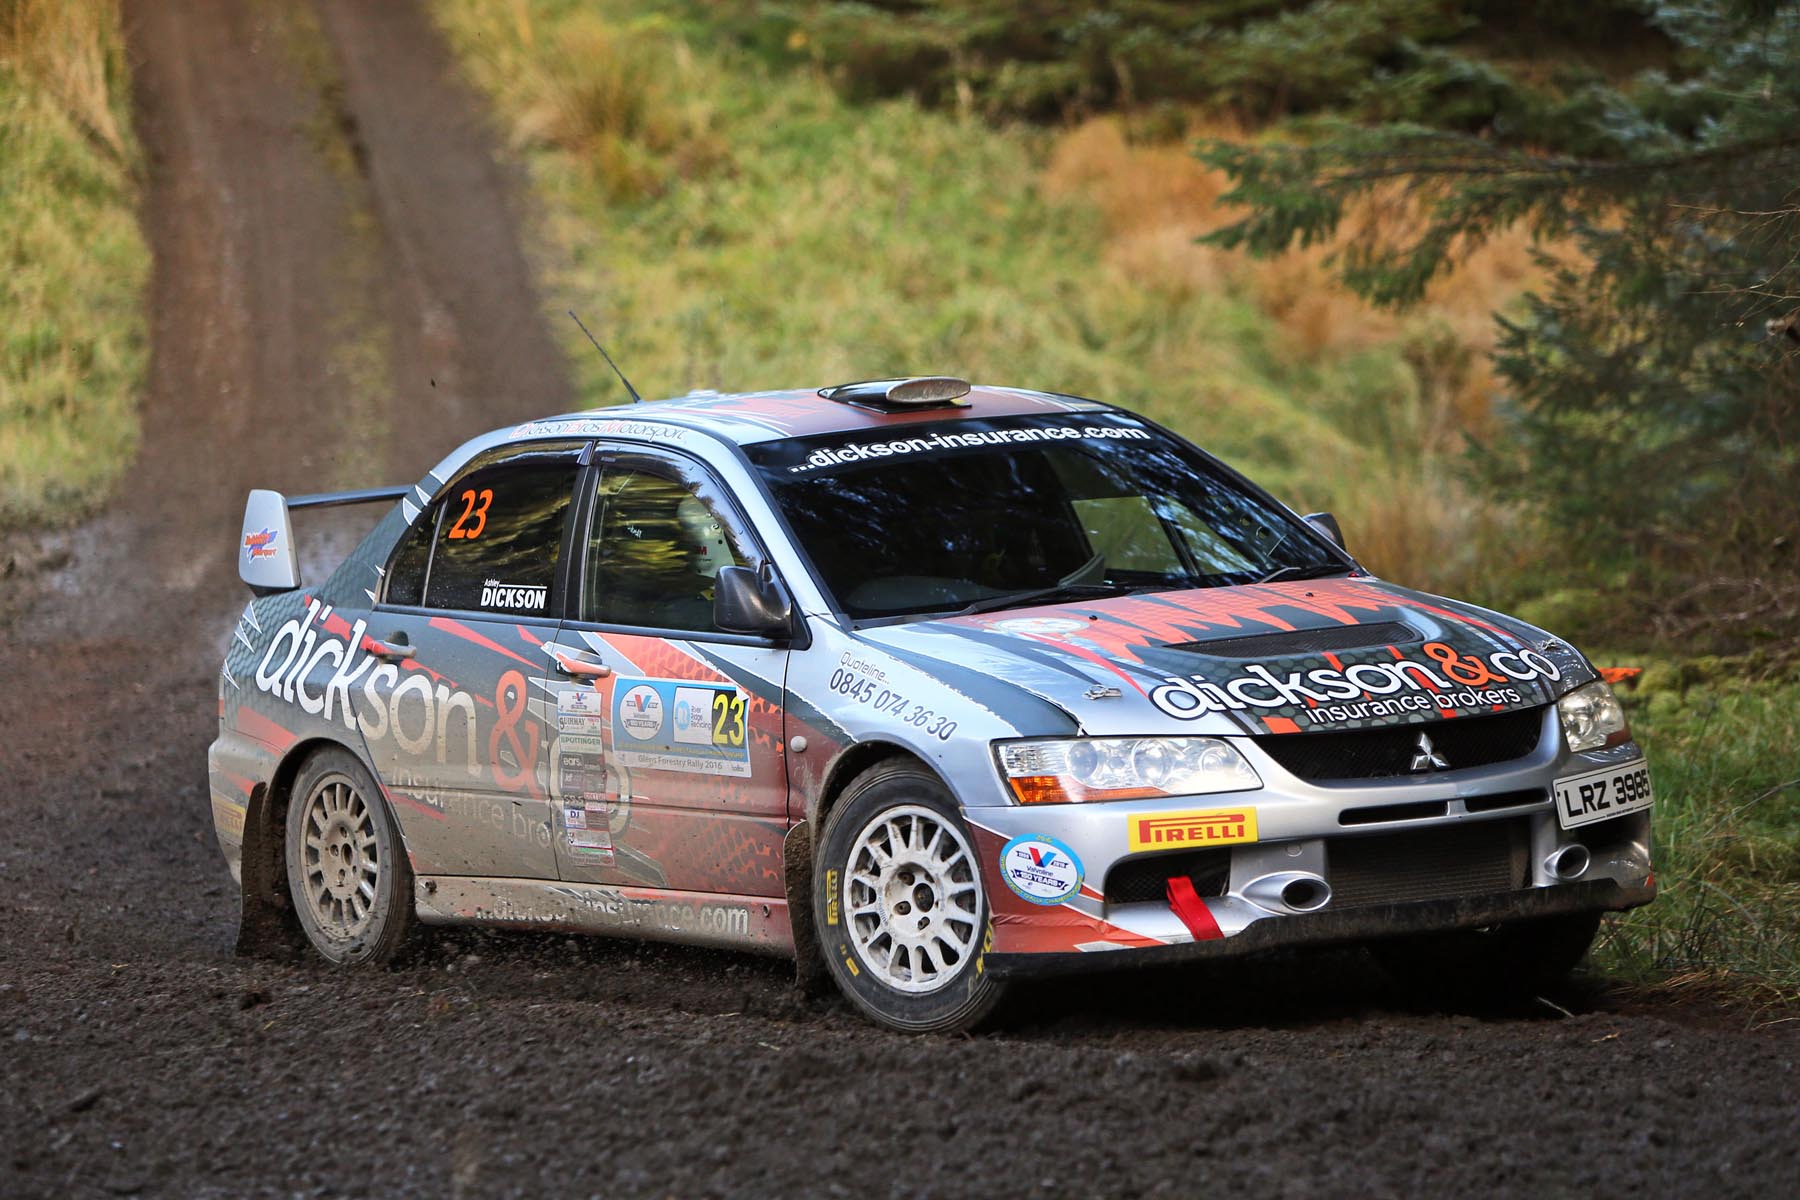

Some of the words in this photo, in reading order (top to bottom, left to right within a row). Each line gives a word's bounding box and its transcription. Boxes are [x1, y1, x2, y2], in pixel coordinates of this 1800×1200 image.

[448, 488, 494, 539] 23
[480, 587, 547, 609] DICKSON
[483, 578, 500, 588] Ashley
[829, 668, 877, 703] 0845
[873, 689, 910, 717] 074
[1304, 695, 1433, 724] insurance
[1436, 685, 1522, 709] brokers
[712, 693, 745, 747] 23
[658, 756, 687, 768] Forestry
[687, 758, 704, 770] Rally
[704, 760, 723, 770] 2016
[1563, 780, 1611, 818] LRZ
[1138, 814, 1246, 844] PIRELLI
[1026, 865, 1054, 878] Valvoline
[1033, 874, 1059, 887] YEARS
